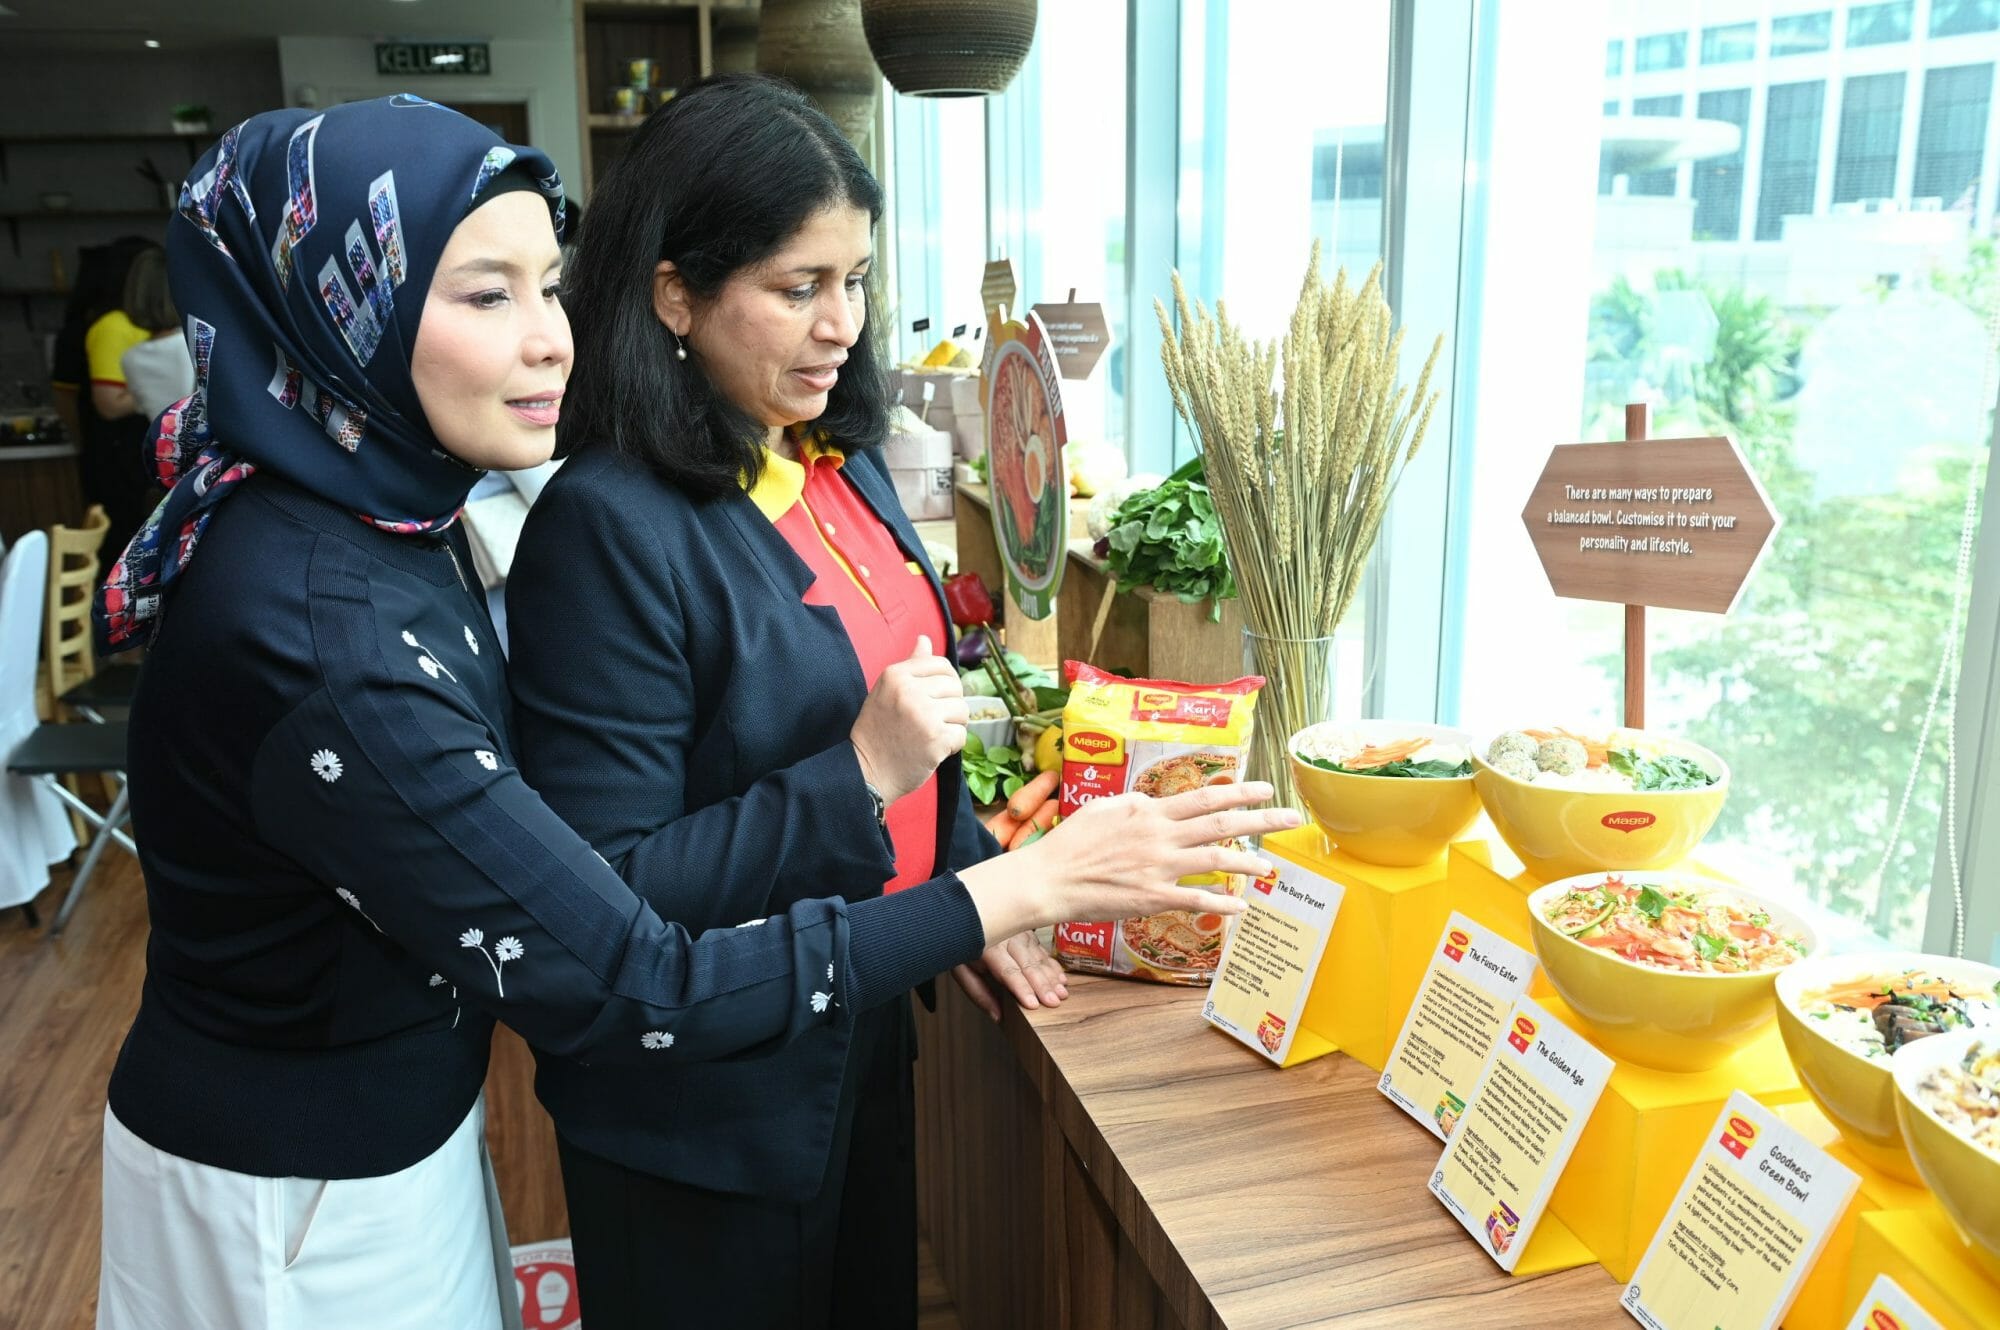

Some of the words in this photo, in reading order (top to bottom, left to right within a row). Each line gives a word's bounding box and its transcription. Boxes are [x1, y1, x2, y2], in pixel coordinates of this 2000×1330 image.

[1565, 485, 1590, 500] There
[1592, 489, 1607, 500] are
[1609, 488, 1632, 502] many
[1634, 488, 1657, 501] ways
[1660, 486, 1669, 499] to
[1672, 487, 1712, 504] prepare
[1547, 514, 1552, 523] a
[1554, 510, 1590, 524] balanced
[1592, 511, 1615, 525] bowl.
[1617, 511, 1665, 526] Customise
[1667, 512, 1674, 526] it
[1677, 513, 1687, 527] to
[1690, 512, 1709, 528] suit
[1712, 515, 1736, 530] your
[1580, 536, 1628, 552] personality
[1631, 537, 1647, 551] and
[1650, 537, 1693, 555] lifestyle.
[1183, 702, 1217, 715] Kari
[1073, 736, 1111, 749] Maggi
[1063, 782, 1115, 806] Ka
[1607, 816, 1650, 826] Maggi
[1278, 881, 1288, 892] The
[1289, 887, 1304, 901] Busy
[1304, 894, 1325, 910] Parent
[1058, 922, 1105, 949] Kari
[1469, 948, 1481, 961] The
[1481, 955, 1500, 973] Fussy
[1499, 966, 1518, 983] Eater
[1537, 1041, 1549, 1057] The
[1549, 1052, 1571, 1075] Golden
[1570, 1070, 1584, 1086] Age
[1770, 1146, 1811, 1182] Goodness
[1759, 1159, 1785, 1185] Green
[1785, 1179, 1809, 1202] Bowl
[1696, 1185, 1712, 1199] paired
[1712, 1197, 1721, 1206] with
[1725, 1209, 1747, 1227] colourful
[1746, 1226, 1759, 1238] array
[1765, 1242, 1791, 1265] vegetables
[1703, 1175, 1728, 1198] ingredients
[1737, 1204, 1764, 1227] mushrooms
[1764, 1226, 1774, 1235] and
[1773, 1234, 1796, 1253] seaweed
[1726, 1180, 1744, 1195] natural
[1743, 1194, 1759, 1208] umami
[1759, 1206, 1776, 1221] flavour
[1776, 1220, 1788, 1232] from
[1789, 1230, 1802, 1243] fresh
[1697, 1200, 1715, 1216] enhance
[1716, 1214, 1724, 1223] the
[1724, 1222, 1740, 1236] overall
[1739, 1234, 1756, 1250] flavour
[1762, 1253, 1770, 1263] the
[1771, 1262, 1781, 1272] dish
